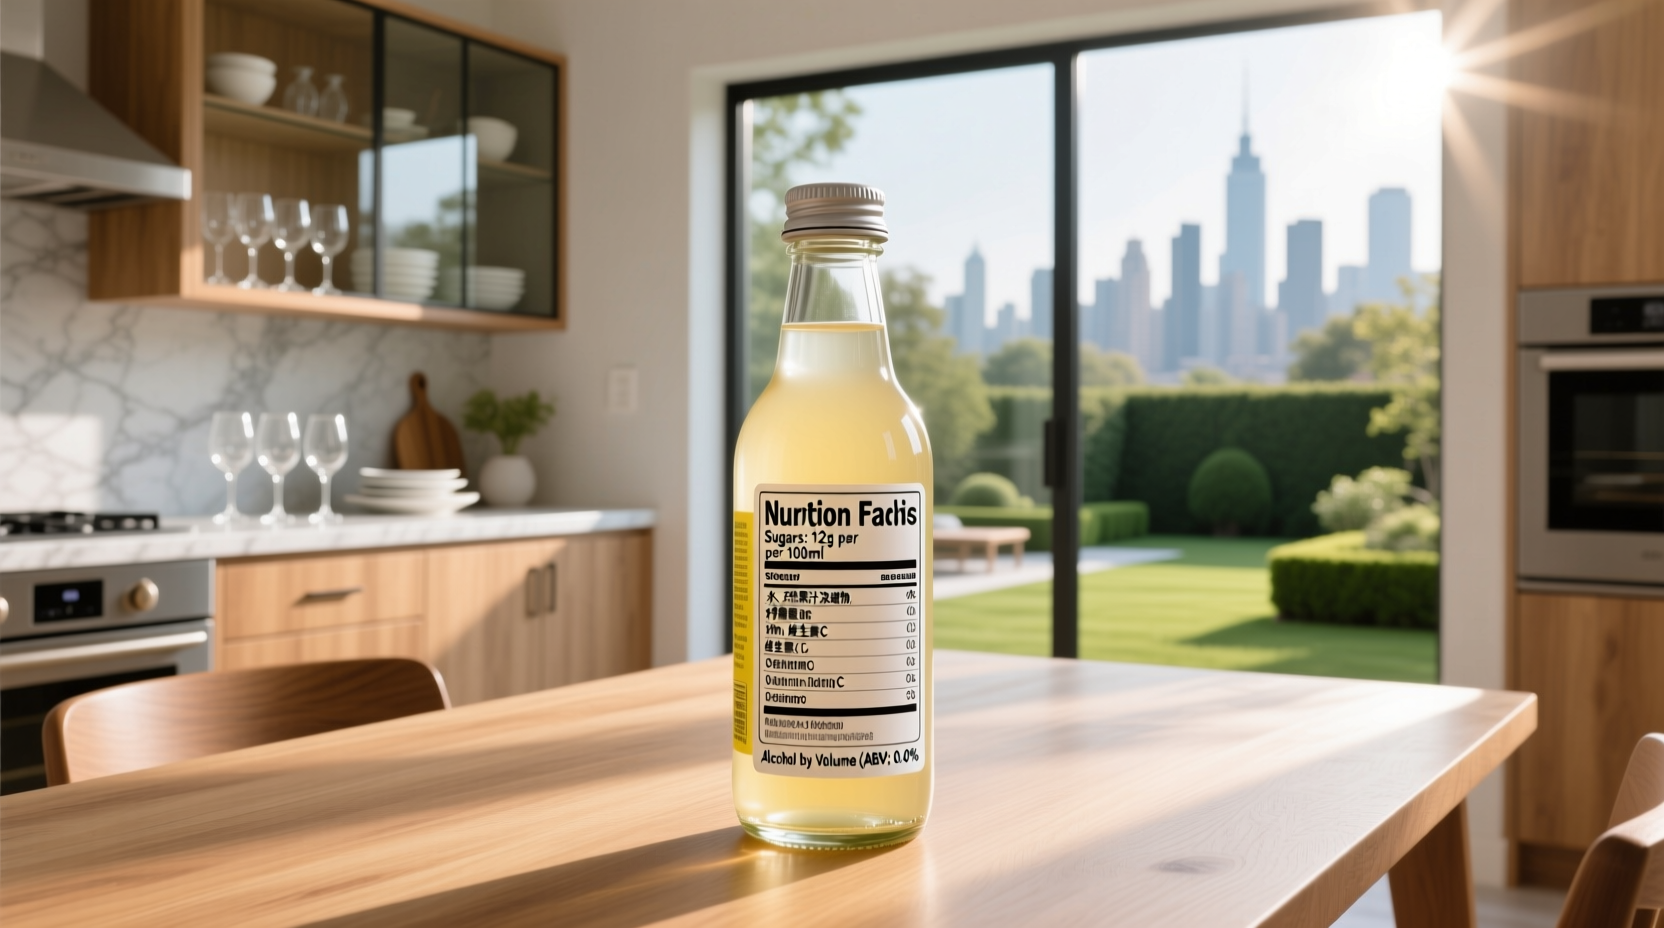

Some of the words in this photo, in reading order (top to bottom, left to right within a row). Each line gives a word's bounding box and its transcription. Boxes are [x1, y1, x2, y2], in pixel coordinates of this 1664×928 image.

[764, 529, 808, 547] Sugars:
[811, 530, 834, 548] 12g
[838, 533, 859, 548] per
[765, 548, 784, 560] per
[787, 545, 825, 560] 100ml
[799, 752, 813, 770] by
